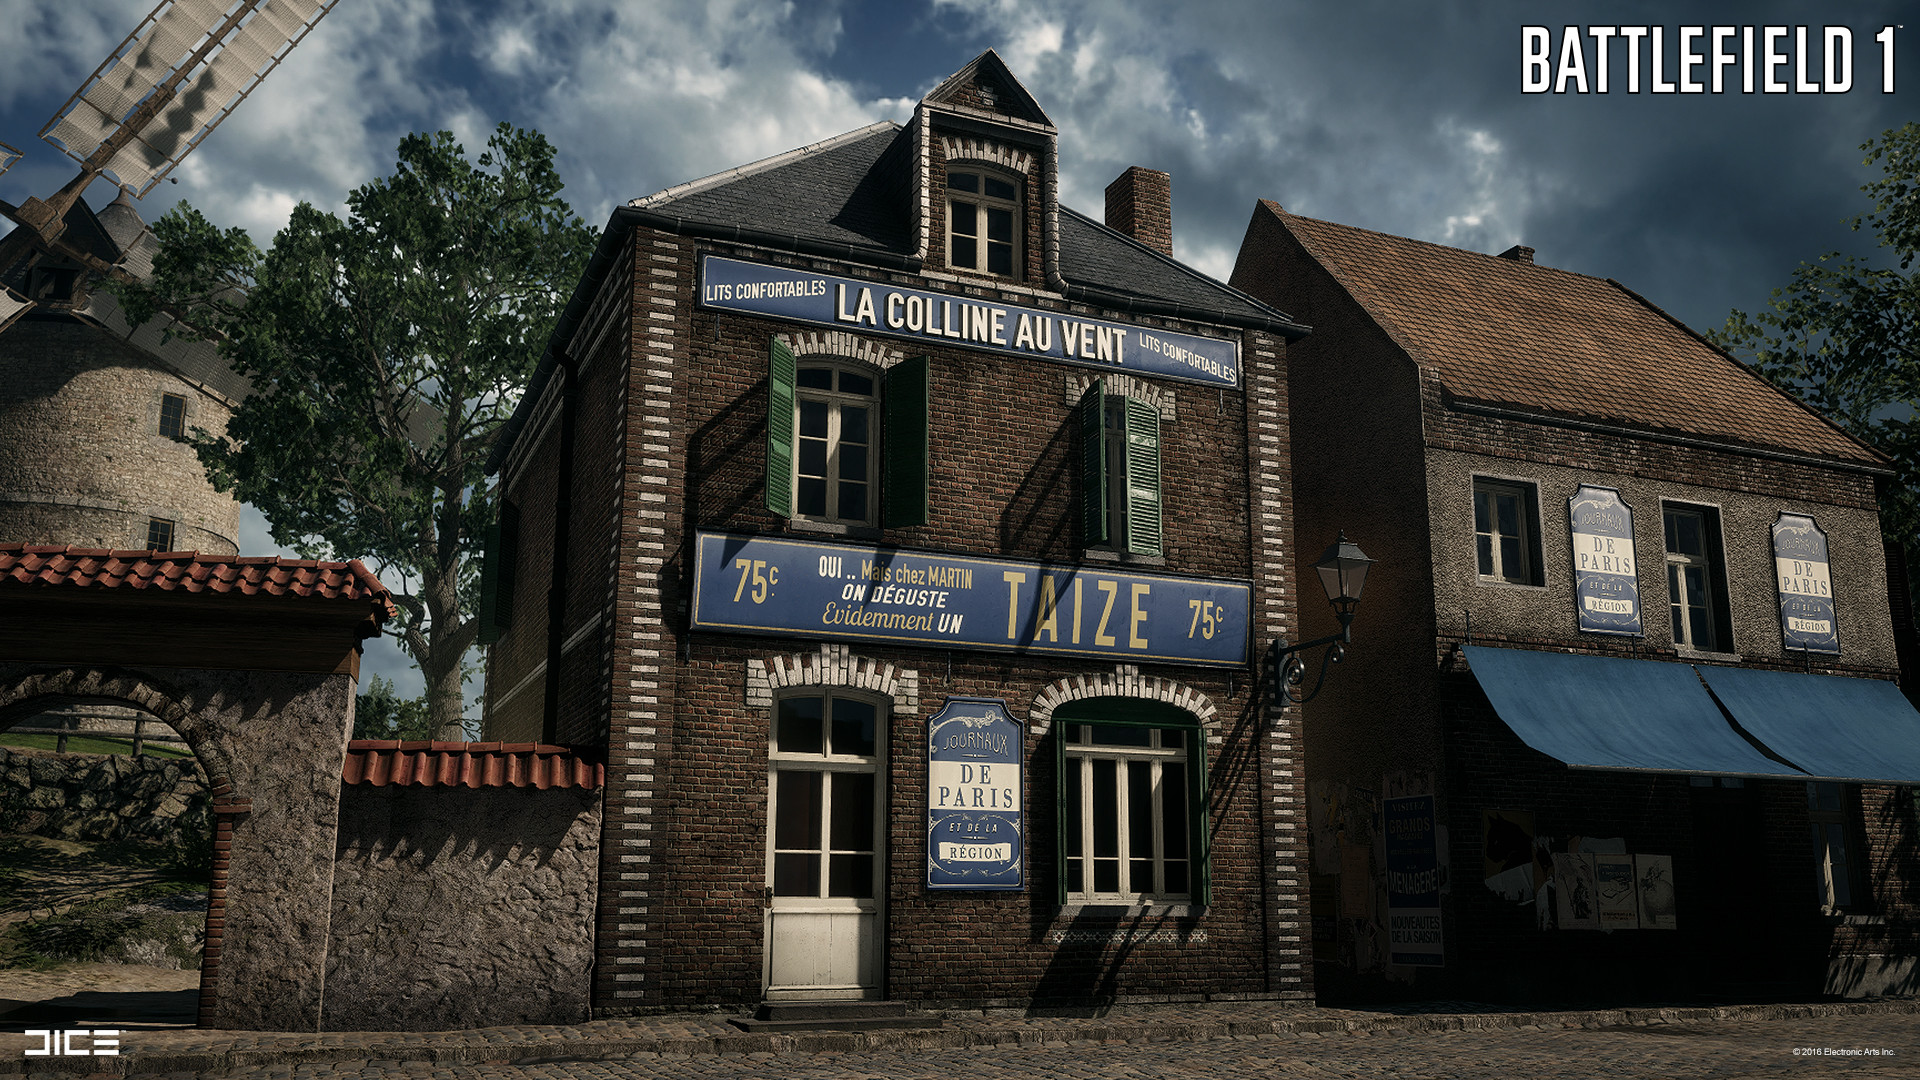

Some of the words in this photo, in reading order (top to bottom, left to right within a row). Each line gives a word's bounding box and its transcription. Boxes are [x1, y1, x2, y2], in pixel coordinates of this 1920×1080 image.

[706, 284, 732, 301] LITS
[736, 280, 826, 300] CONFORTABLES
[837, 283, 877, 326] LA
[886, 292, 1007, 346] COLLINE
[1014, 313, 1052, 352] AU
[1061, 319, 1127, 364] VENT
[1139, 332, 1161, 352] LITS
[1163, 341, 1236, 383] CONFORTABLES
[1593, 536, 1615, 554] DE
[818, 555, 842, 578] OUI
[861, 559, 892, 582] Mais
[895, 563, 925, 586] chez
[928, 565, 973, 590] MARTIN
[1580, 553, 1631, 574] PARIS
[1793, 561, 1813, 577] DE
[841, 583, 867, 602] ON
[871, 584, 949, 609] DÉGUSTE
[1783, 576, 1828, 596] PARIS
[1003, 570, 1150, 650] TAIZE
[1591, 599, 1628, 613] RÉGION
[822, 601, 934, 632] Evidemment
[937, 613, 964, 634] UN
[943, 731, 1008, 756] JOURNAUX
[960, 763, 991, 785] DE
[938, 786, 1013, 809] PARIS
[949, 822, 962, 833] ET
[967, 822, 979, 833] DE
[985, 823, 998, 833] LA
[1389, 816, 1431, 835] GRANDS
[950, 844, 1002, 859] RÉGION
[1391, 930, 1402, 943] DE
[1403, 930, 1413, 943] LA
[1413, 930, 1441, 944] SAISON
